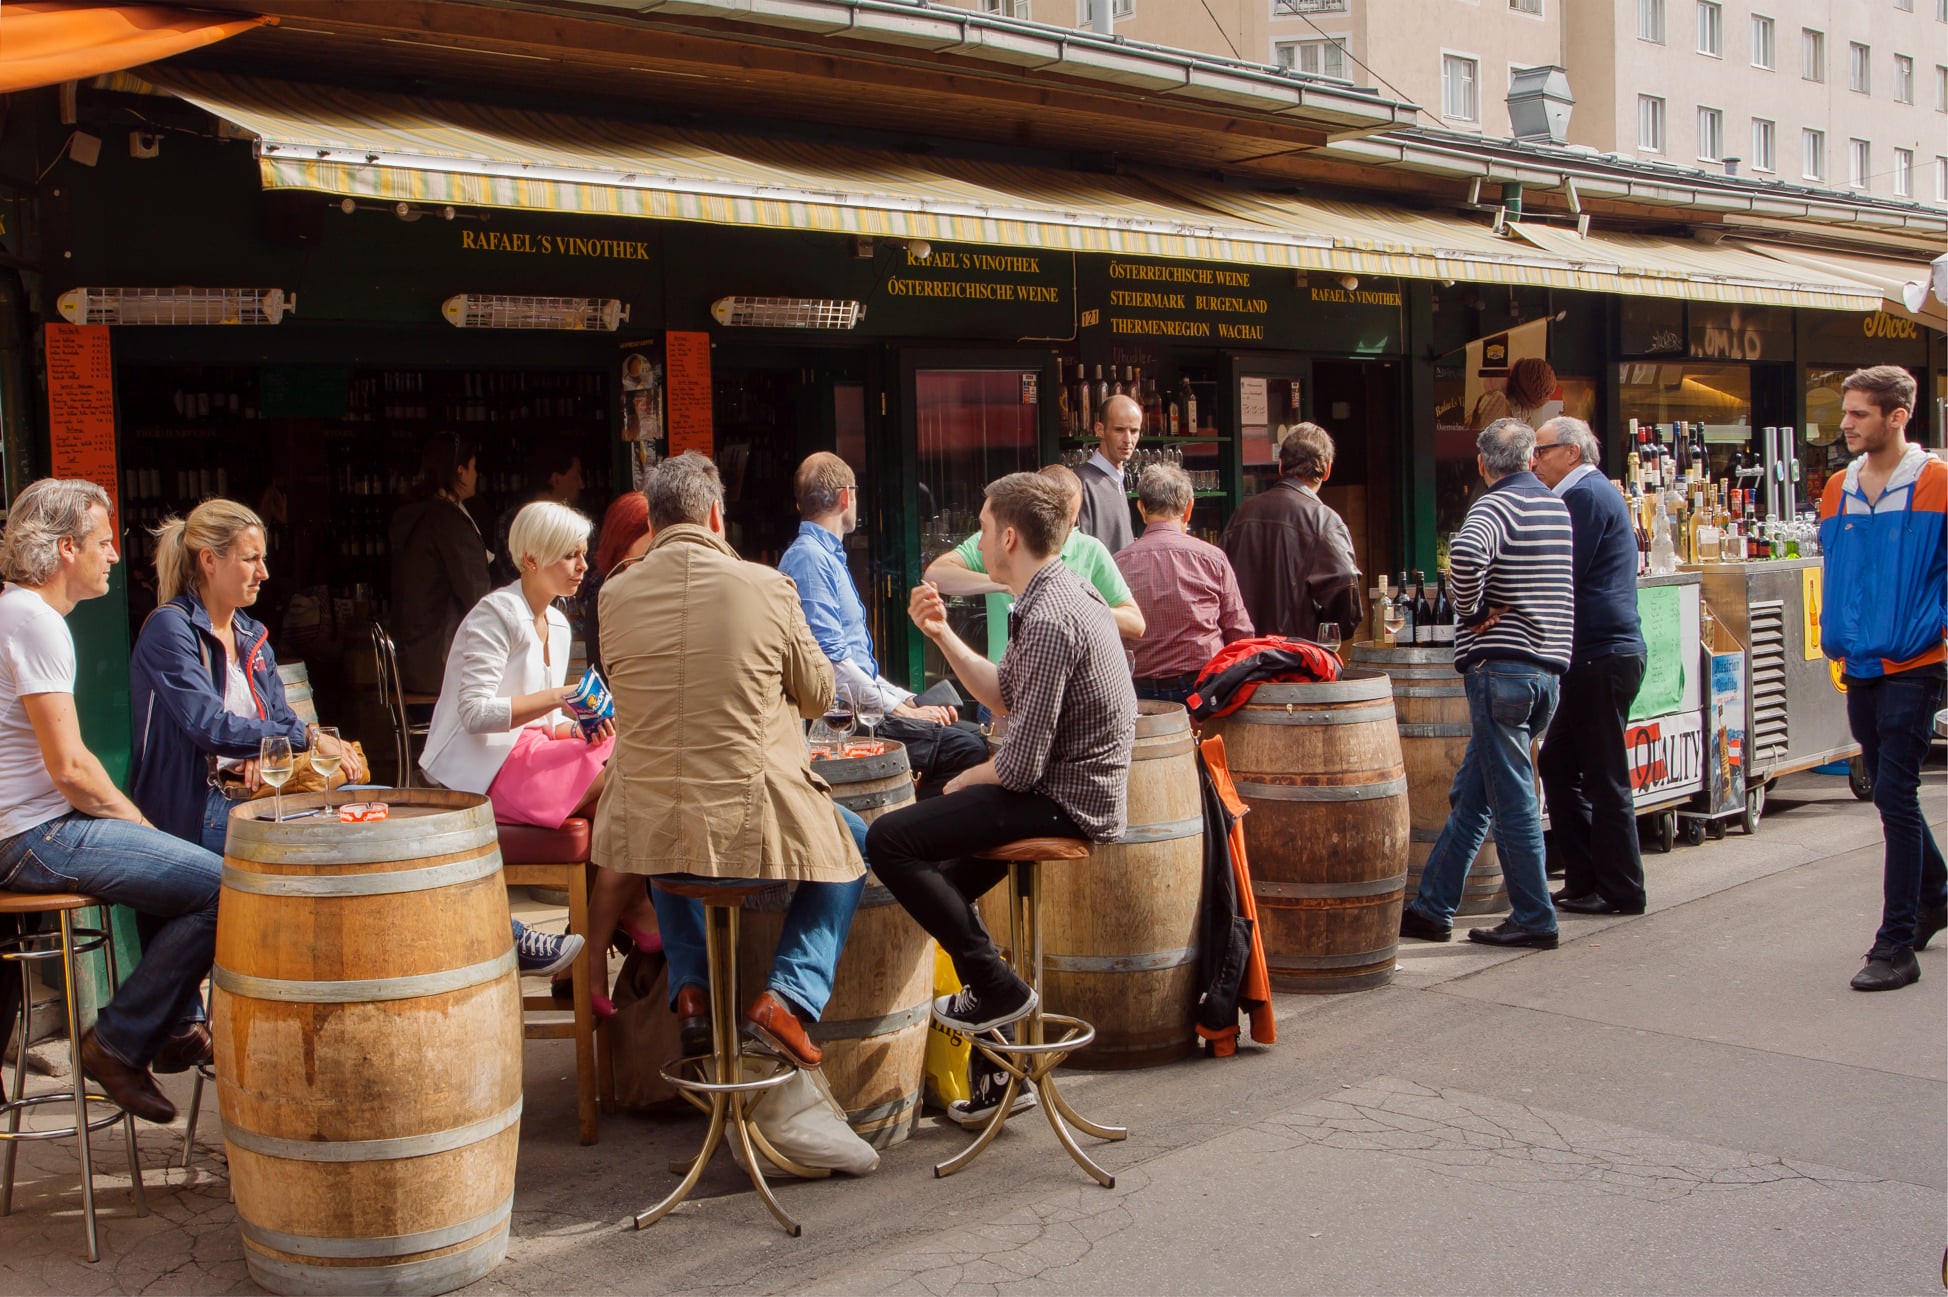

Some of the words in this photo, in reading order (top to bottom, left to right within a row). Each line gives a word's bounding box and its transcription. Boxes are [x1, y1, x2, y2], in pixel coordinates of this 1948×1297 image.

[556, 237, 649, 259] VINOTHEK
[973, 254, 1040, 273] VINOTHEK
[1110, 260, 1214, 284] ÖSTERREICHISCHE
[1215, 270, 1250, 287] WEINE
[888, 276, 1014, 300] ÖSTERREICHISCHE
[1016, 286, 1059, 303] WEINE
[1355, 291, 1401, 306] VINOTHEK
[1110, 291, 1185, 309] STEIERMARK
[1196, 295, 1267, 313] BURGENLAND
[1082, 310, 1098, 326] 121
[1111, 318, 1210, 336] THERMENREGION
[1219, 324, 1264, 340] WACHAU
[1634, 728, 1700, 793] QUALITY
